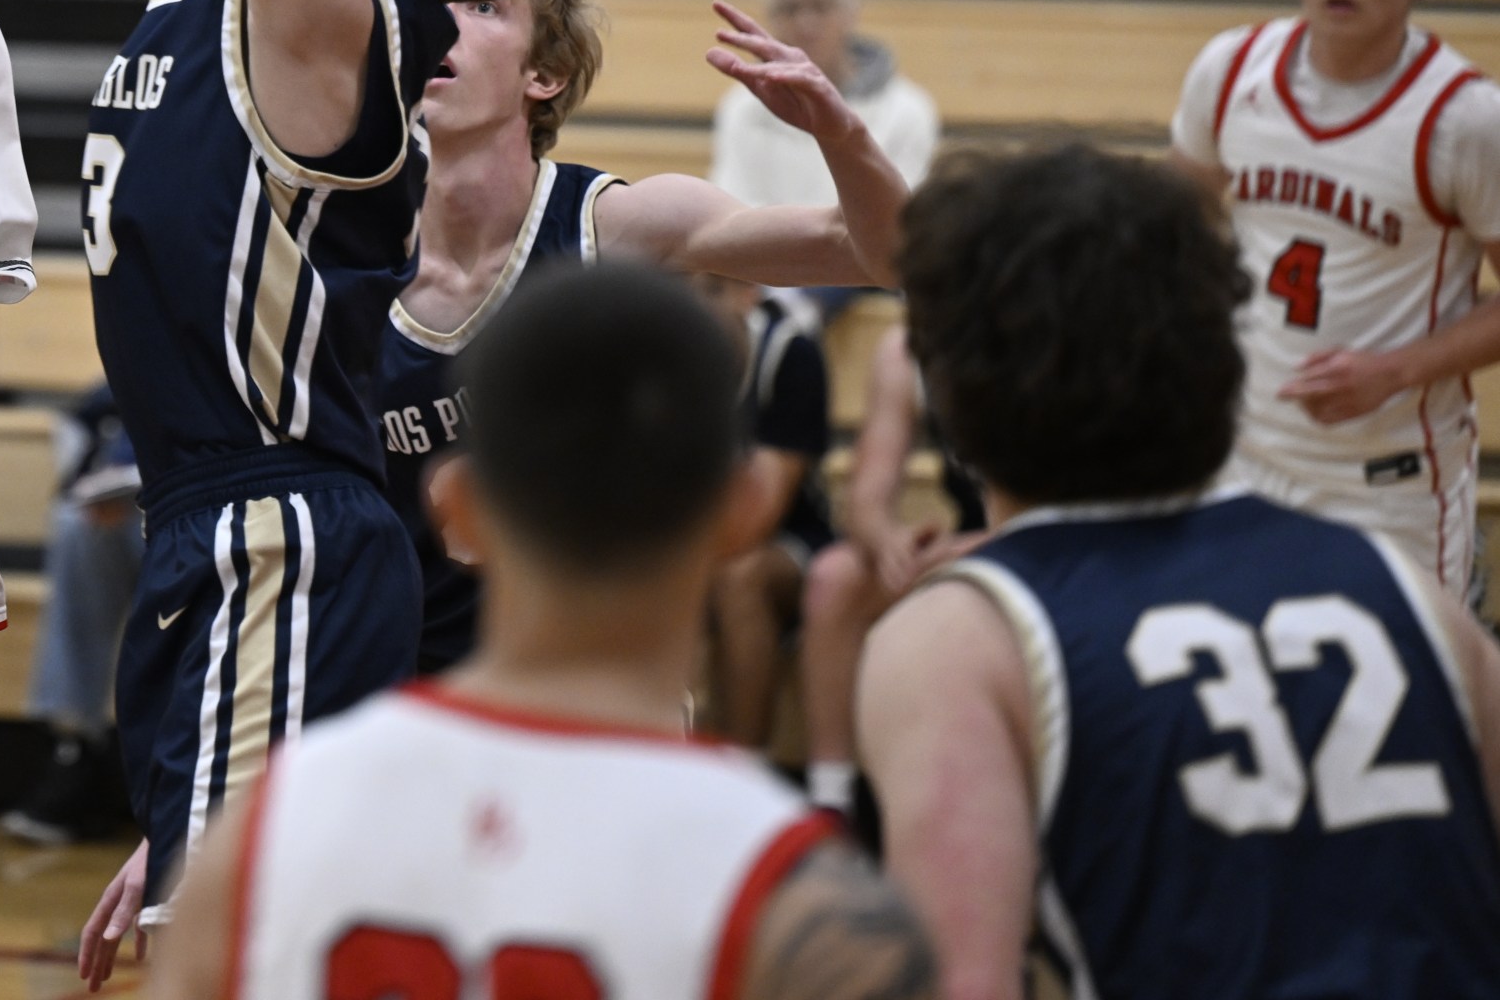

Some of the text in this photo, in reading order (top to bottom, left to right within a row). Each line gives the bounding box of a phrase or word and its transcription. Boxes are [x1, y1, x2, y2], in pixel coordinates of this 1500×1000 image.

[80, 132, 126, 277] 3
[1233, 163, 1404, 248] ARDINALS
[1266, 236, 1327, 334] 4
[381, 404, 432, 456] OS
[1124, 592, 1452, 838] 32
